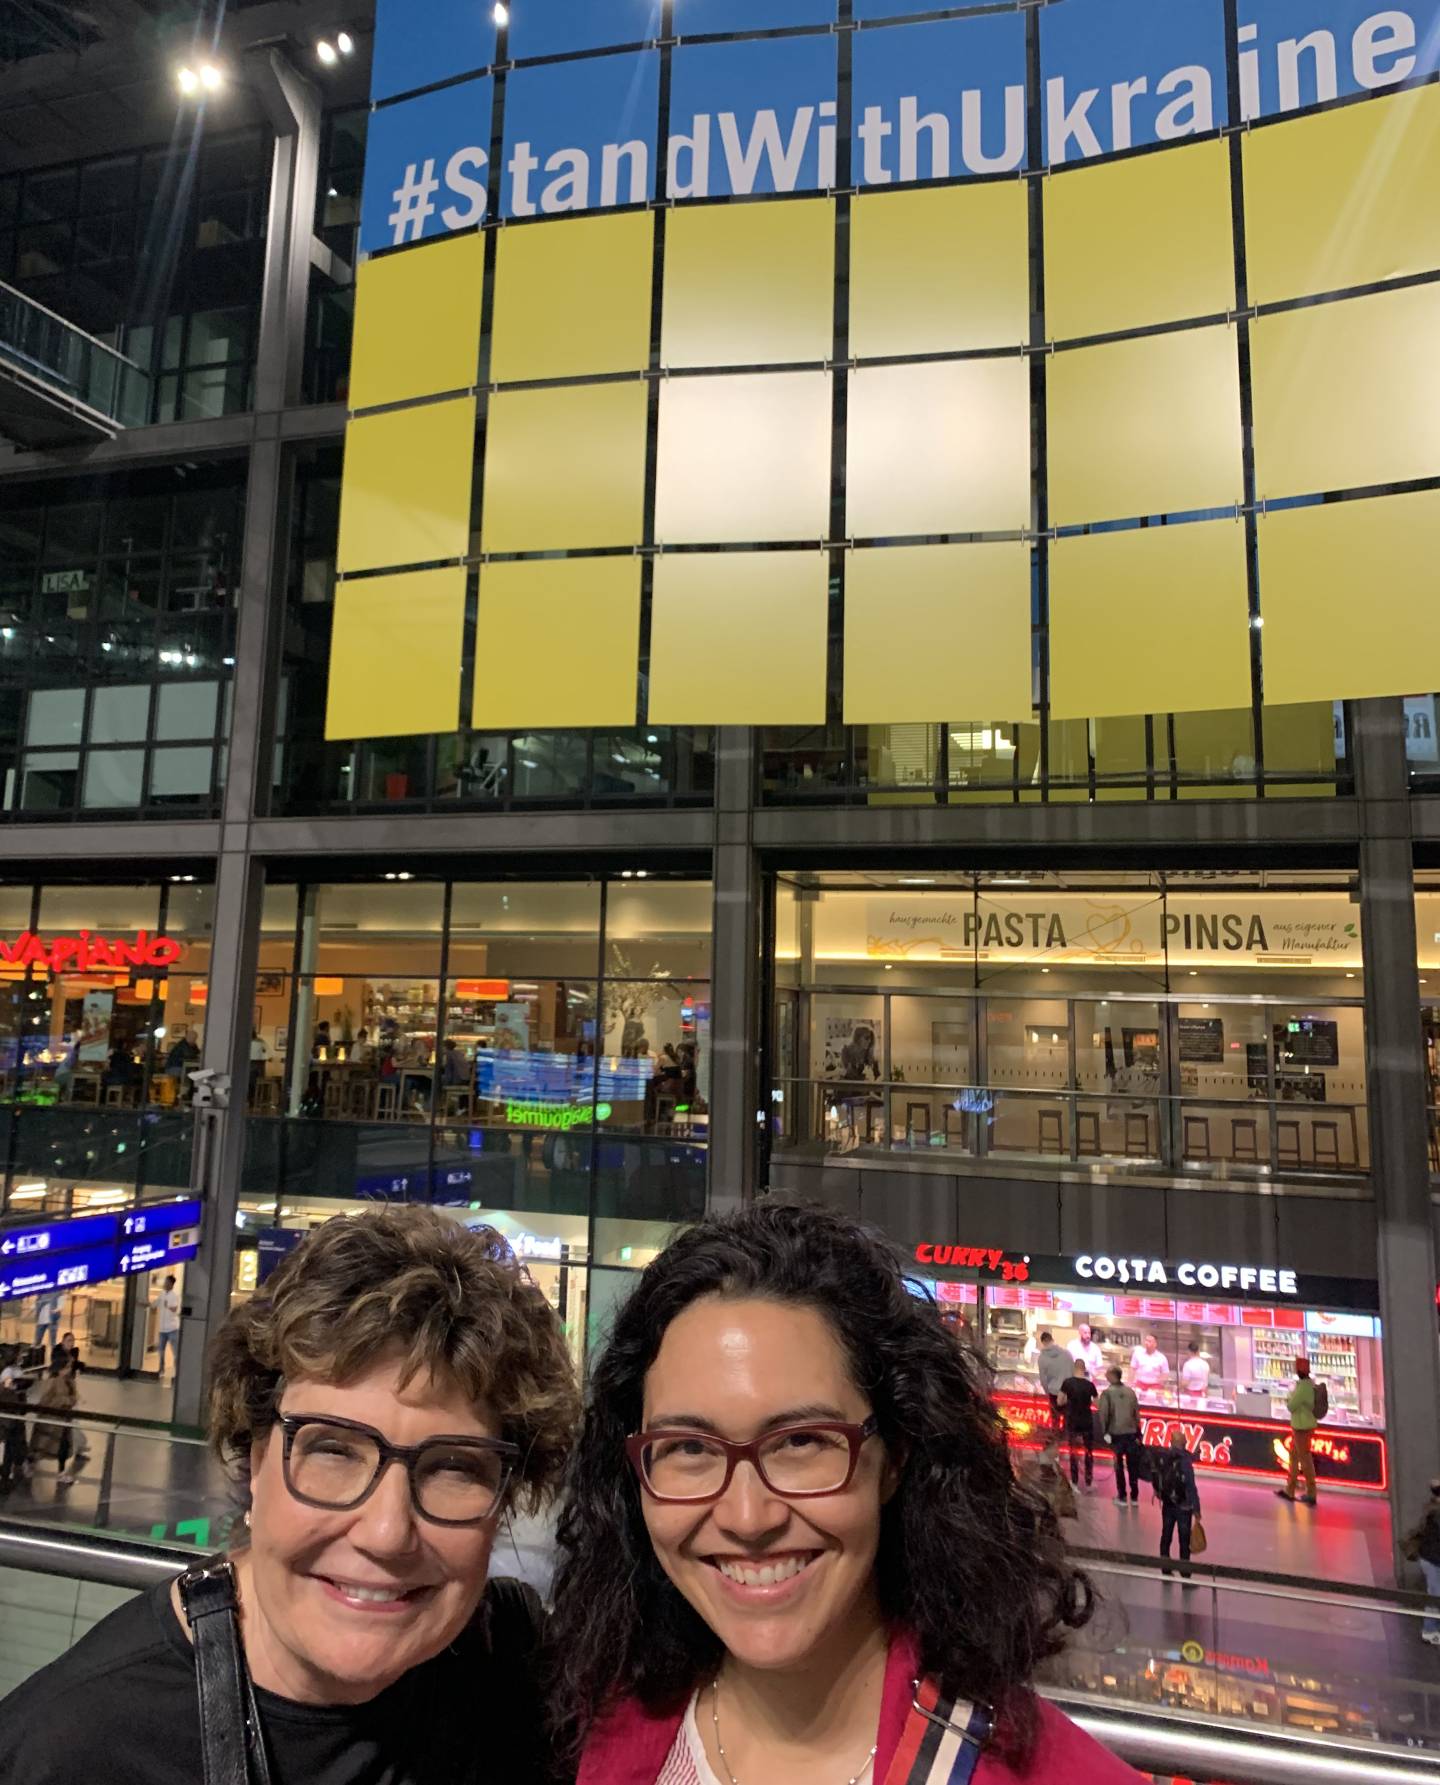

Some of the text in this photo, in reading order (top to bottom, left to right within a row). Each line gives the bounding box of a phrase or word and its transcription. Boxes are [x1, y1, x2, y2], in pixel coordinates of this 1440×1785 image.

[388, 10, 1417, 246] #StandWithUkraine
[889, 911, 957, 928] hausgemachte
[963, 912, 1269, 951] PASTA PINSA
[1272, 921, 1337, 936] aus eigener
[1281, 936, 1350, 951] Manufaktur
[915, 1243, 1029, 1281] CURRY 36
[1075, 1256, 1298, 1294] COSTA COFFEE
